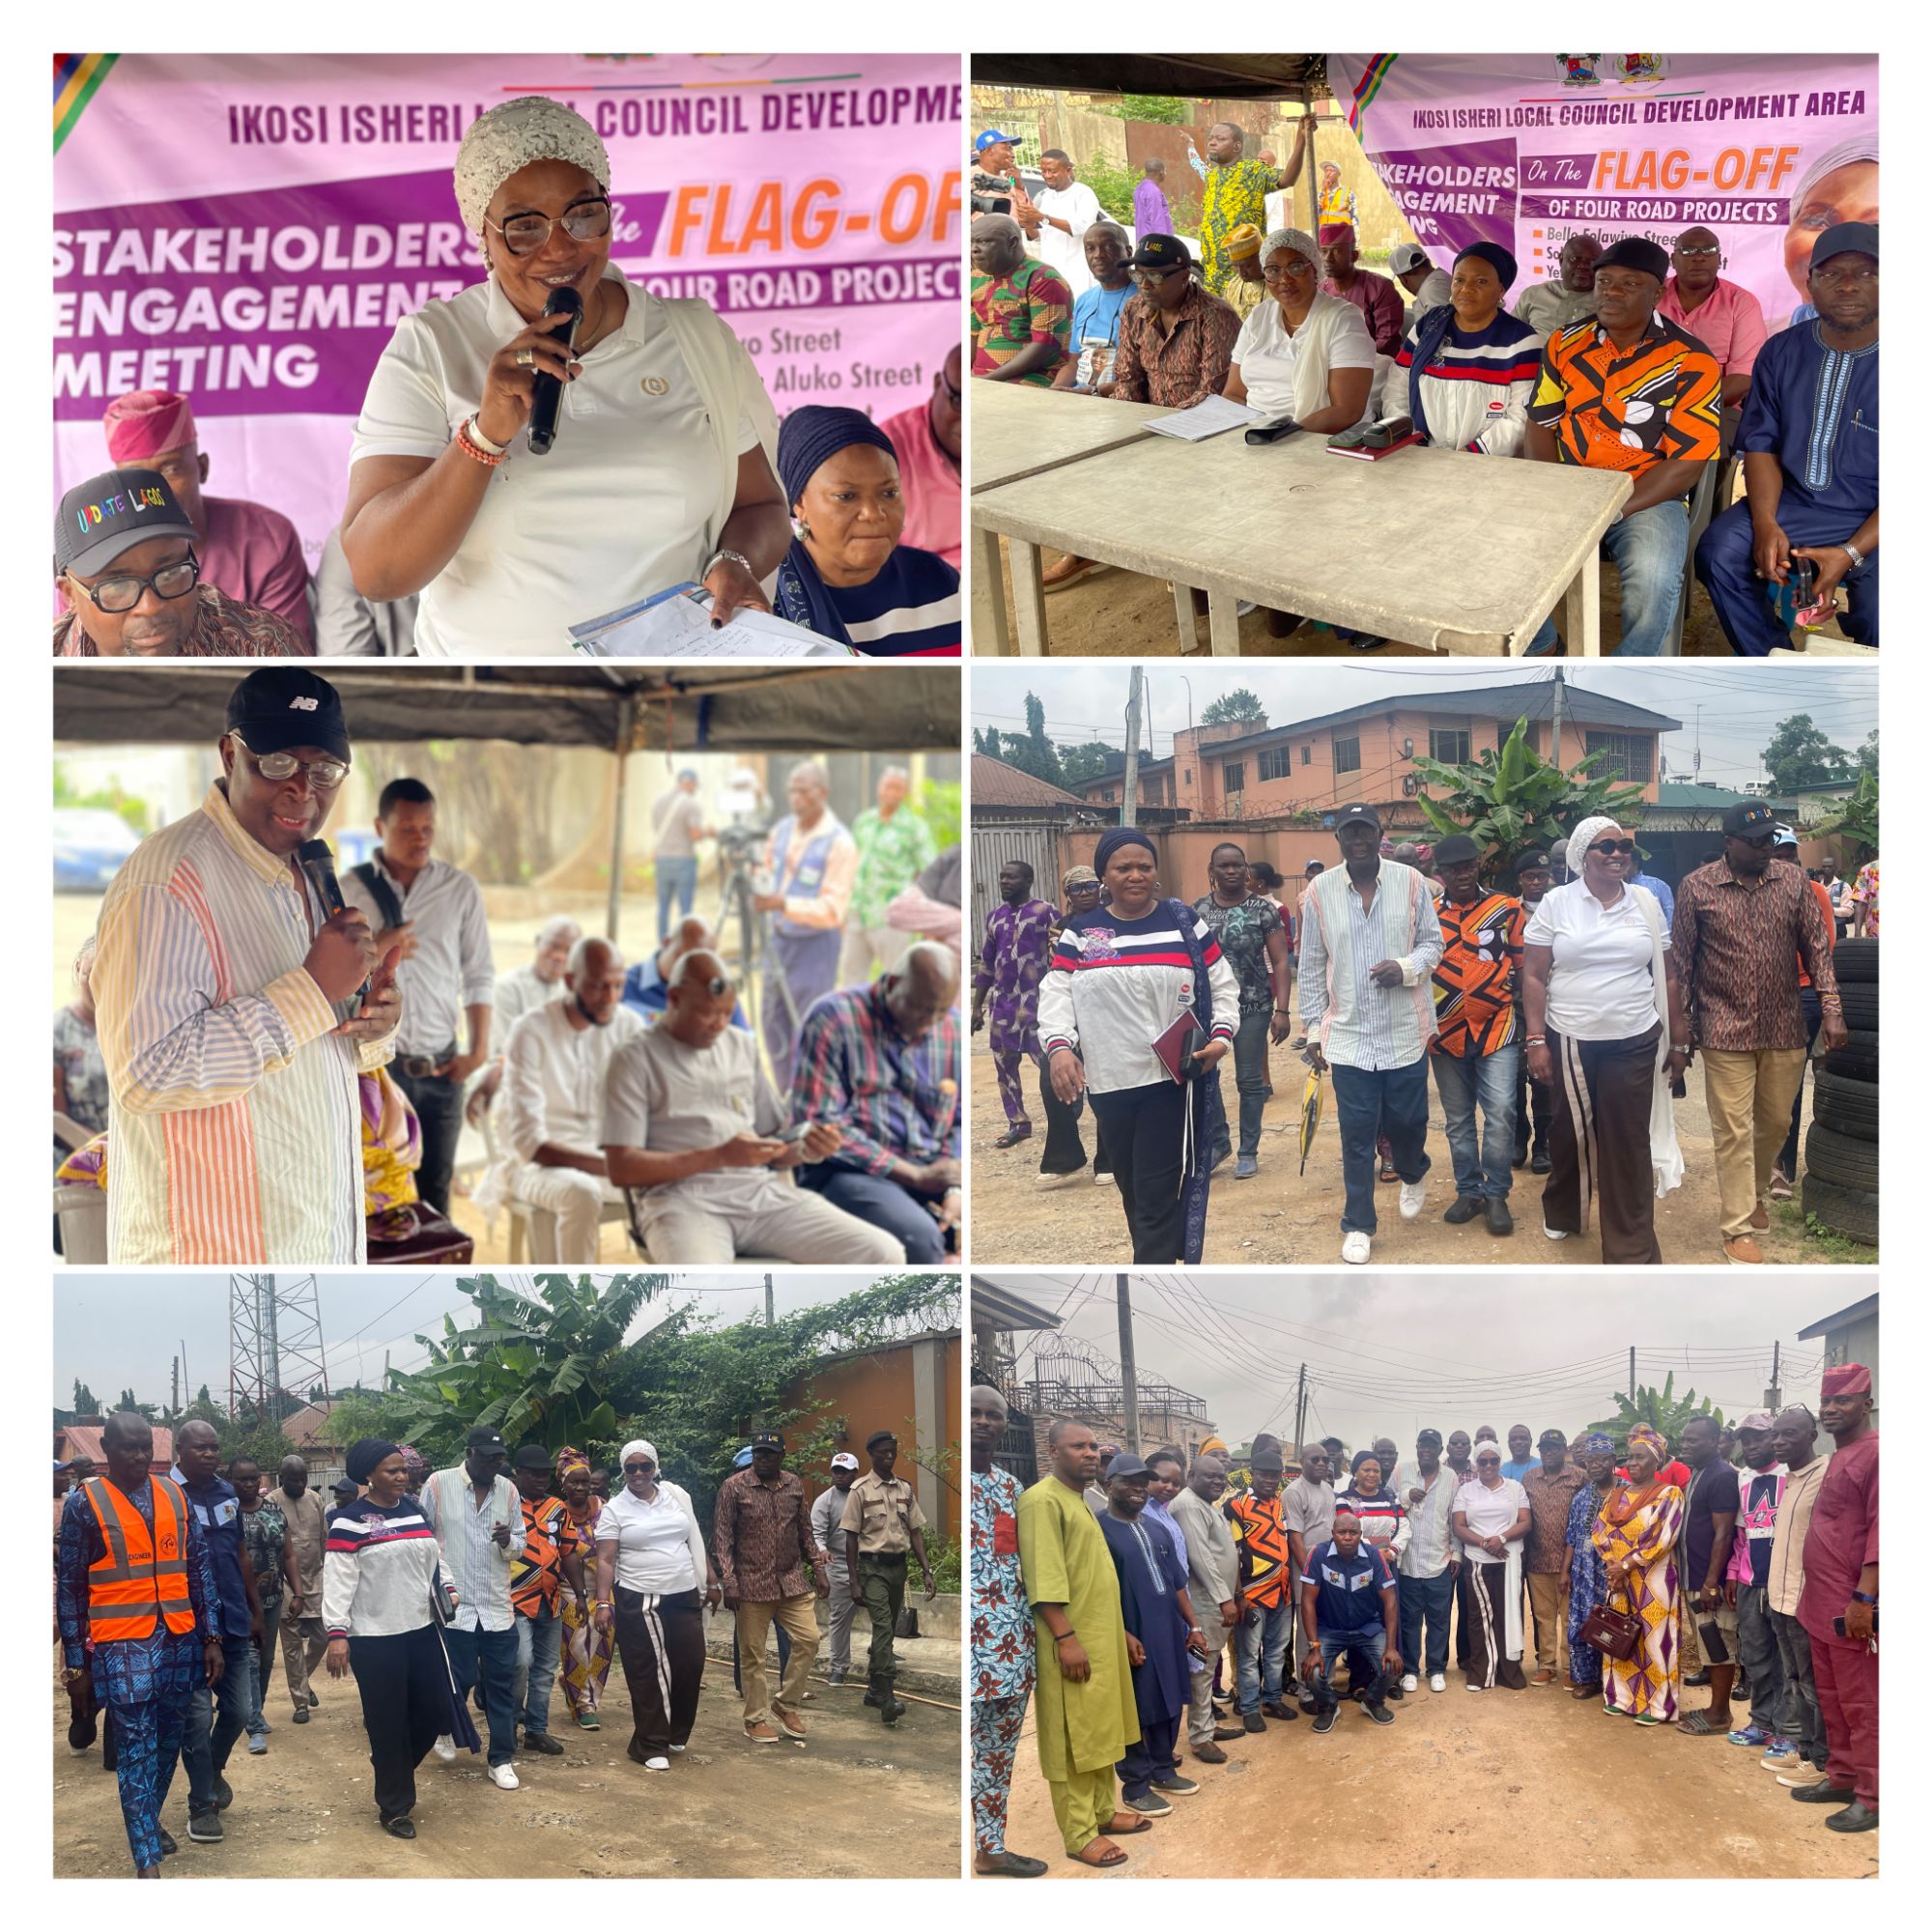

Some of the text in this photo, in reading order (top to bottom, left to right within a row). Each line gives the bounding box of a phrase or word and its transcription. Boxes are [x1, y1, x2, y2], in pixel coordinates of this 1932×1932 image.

[229, 104, 328, 145] IKOSI
[341, 103, 461, 144] ISHERI
[595, 93, 748, 139] COUNCIL
[761, 85, 961, 132] DEVELOPME
[1413, 91, 1865, 128] IKOSI ISHERI LOCAL COUNCIL DEVELOPMENT AREA
[1527, 146, 1801, 191] On The FLAG-OFF
[611, 201, 641, 243] he
[1548, 199, 1777, 222] OF FOUR ROAD PROJECTS
[53, 223, 484, 278] STAKEHOLDERS
[1644, 231, 1677, 246] Stree
[53, 279, 463, 338] ENGAGEMENT
[727, 270, 824, 309] ROAD
[770, 327, 841, 355] Street
[53, 344, 320, 398] MEETING
[774, 361, 923, 393] Aluko Street
[77, 494, 126, 533] UPDATE
